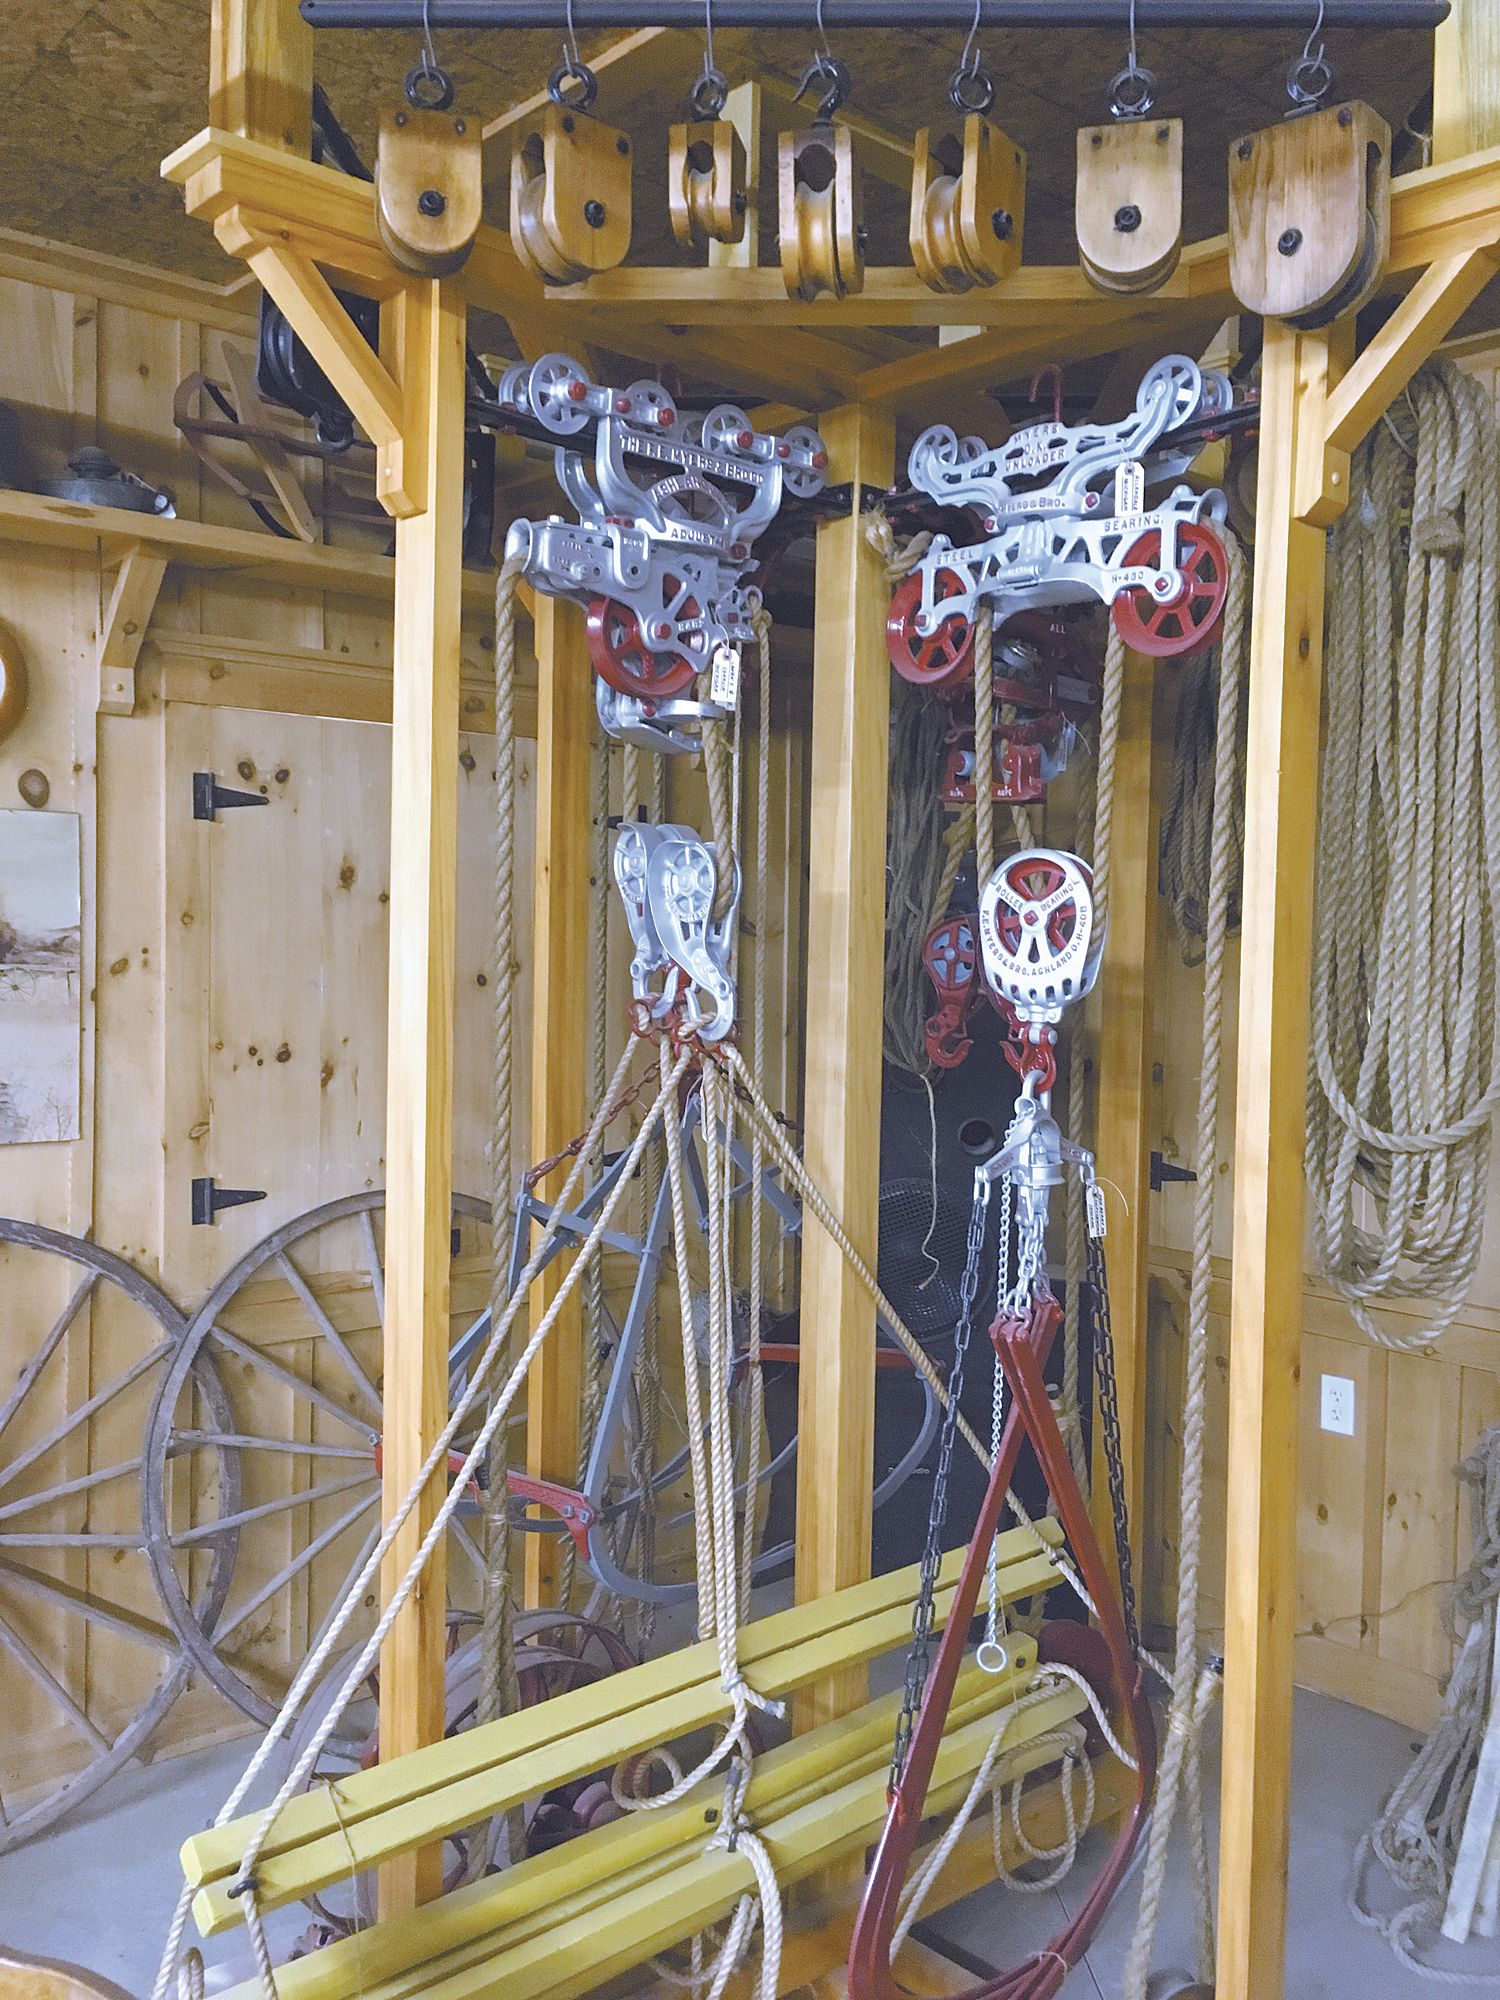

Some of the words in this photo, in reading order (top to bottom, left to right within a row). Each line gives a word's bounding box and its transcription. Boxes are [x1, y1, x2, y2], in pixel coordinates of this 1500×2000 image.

[1014, 424, 1058, 442] MYERS
[619, 434, 645, 454] THE
[671, 448, 712, 469] MYERS
[1005, 448, 1065, 472] UNLOADER
